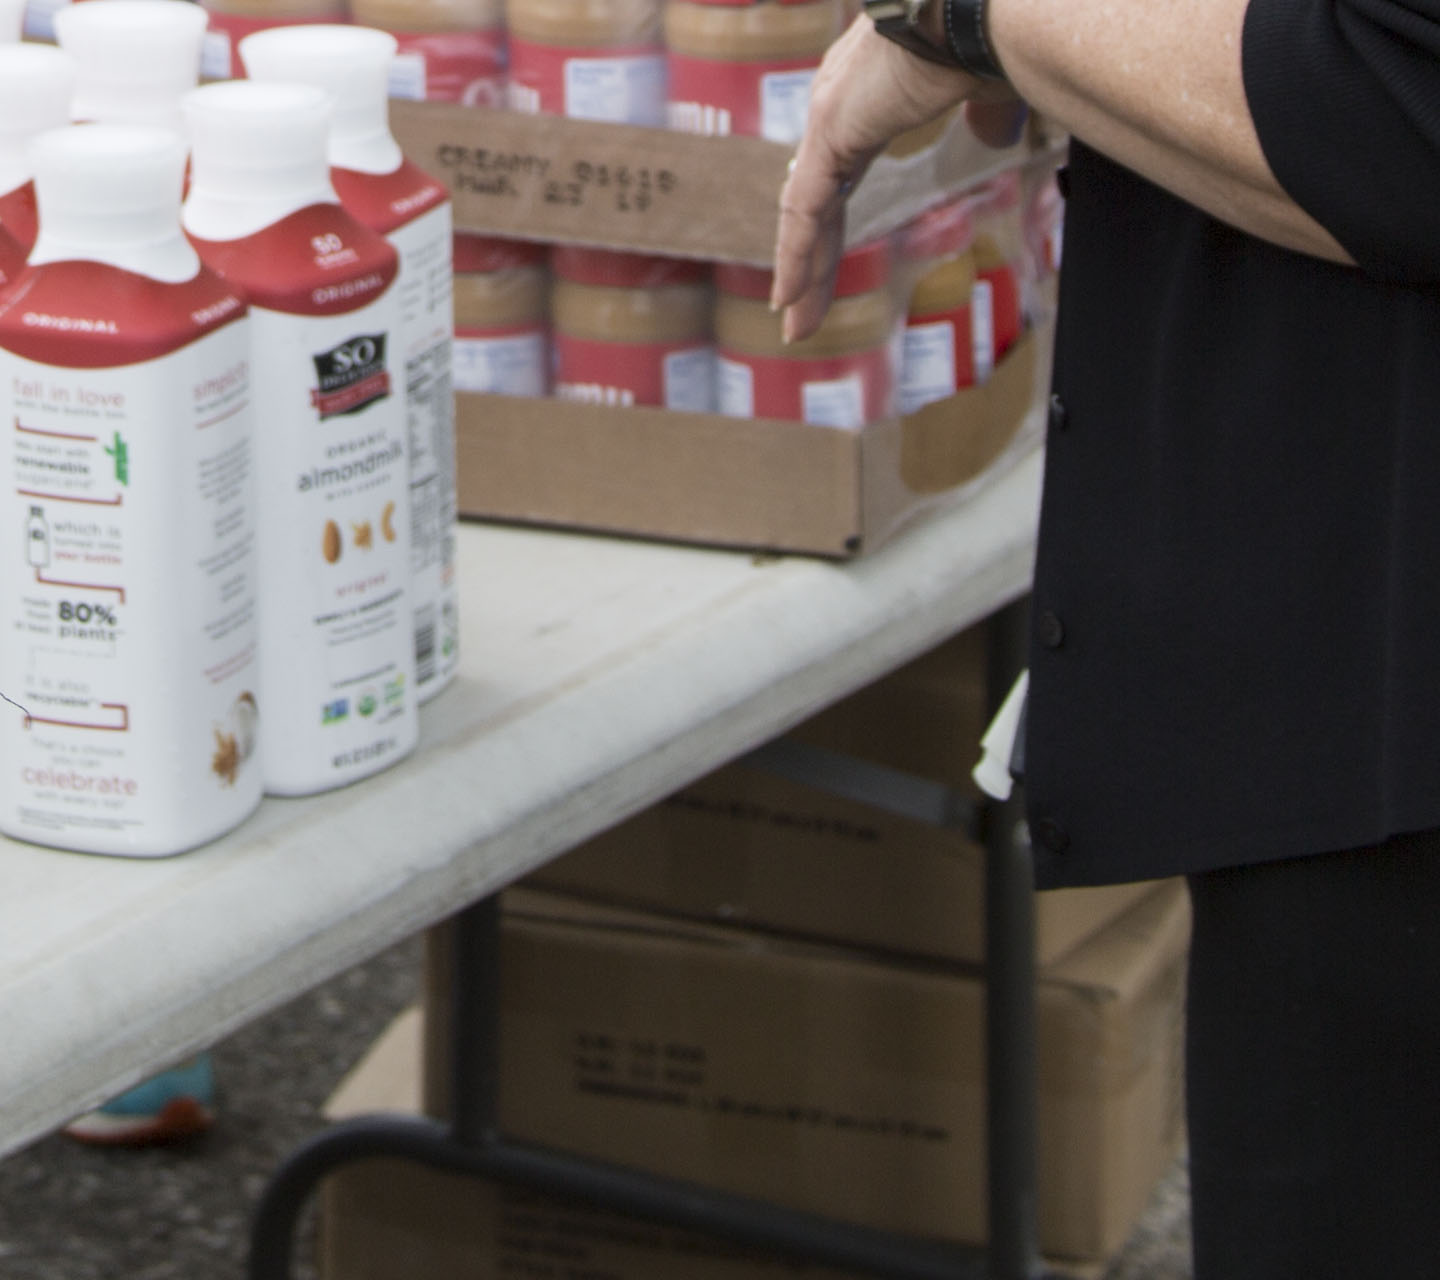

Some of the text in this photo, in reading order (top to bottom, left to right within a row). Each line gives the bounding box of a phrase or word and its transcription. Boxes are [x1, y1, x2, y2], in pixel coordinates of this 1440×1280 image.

[311, 233, 343, 254] SO
[312, 274, 384, 304] ORIGINAL
[22, 312, 119, 334] ORIGINAL
[332, 337, 377, 374] SO
[51, 381, 71, 399] in
[79, 384, 124, 407] love
[325, 430, 388, 459] ORGANIC
[296, 441, 404, 492] almondmilk
[54, 522, 102, 538] which
[58, 600, 118, 626] 80%
[21, 766, 138, 796] celebrate
